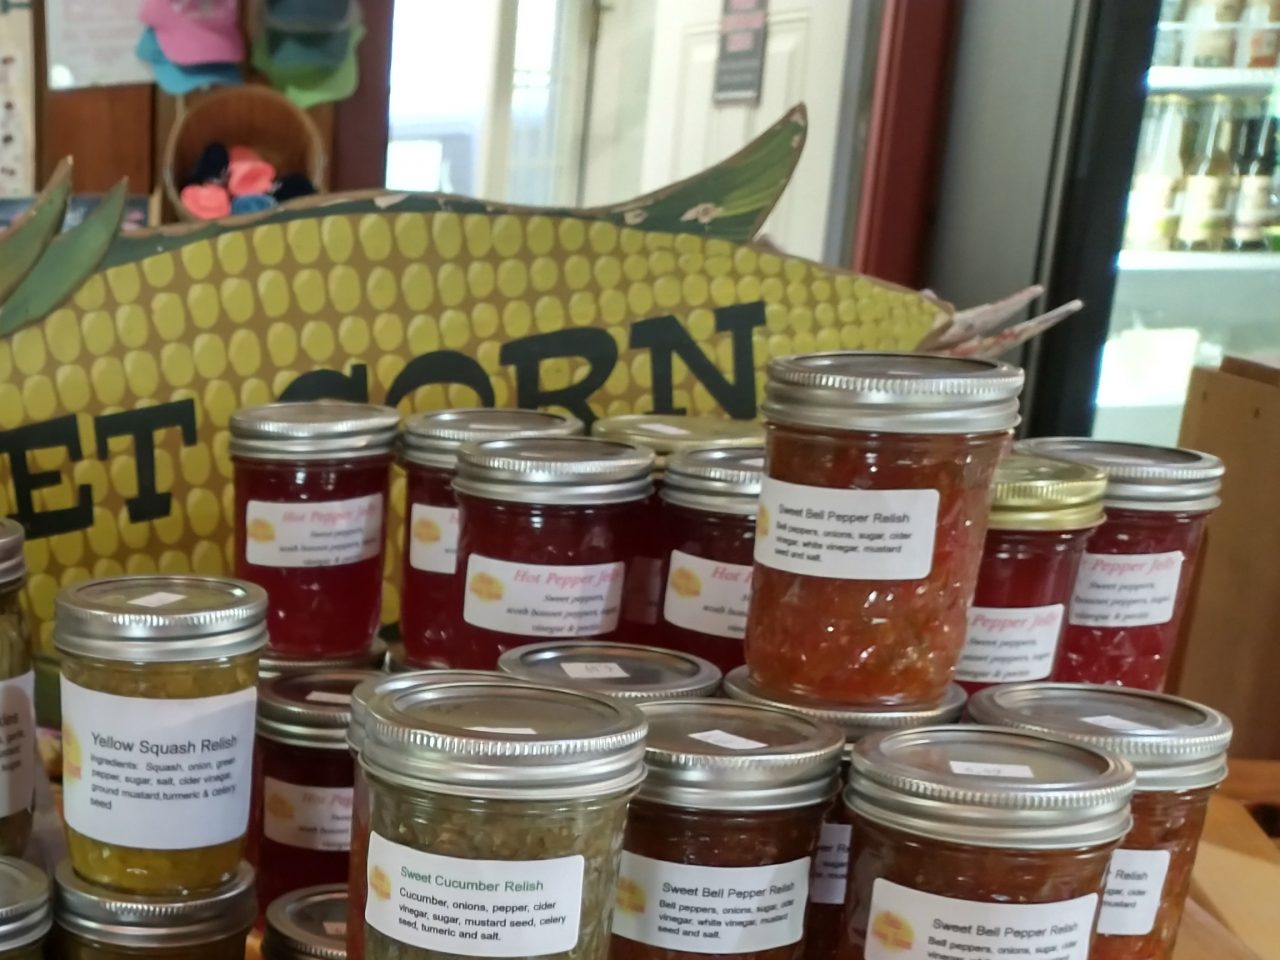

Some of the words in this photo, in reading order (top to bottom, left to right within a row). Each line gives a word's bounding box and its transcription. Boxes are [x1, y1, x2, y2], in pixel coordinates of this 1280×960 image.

[806, 509, 824, 519] Bell
[827, 511, 869, 523] Pepper
[873, 513, 910, 523] Relish
[91, 732, 134, 752] Yellow
[139, 740, 196, 757] Squash
[201, 734, 237, 750] Relish
[401, 866, 431, 884] Sweet
[435, 875, 499, 892] Cucumber
[504, 880, 543, 892] Relish
[1115, 869, 1148, 881] Relish
[399, 887, 449, 909] Cucumber,
[453, 900, 489, 913] onions,
[492, 904, 530, 914] pepper,
[533, 901, 556, 911] cider
[662, 882, 698, 896] Sweet
[702, 888, 724, 898] Bell
[728, 889, 767, 900] Pepper
[399, 904, 430, 920] vinegar,
[432, 914, 461, 926] sugar,
[465, 917, 506, 927] mustard
[510, 918, 536, 928] seed,
[539, 915, 566, 925] celery
[459, 930, 477, 939] and
[480, 931, 501, 941] salt.
[932, 918, 972, 935] Sweet
[976, 924, 1000, 937] Bell
[1004, 926, 1047, 939] Pepper
[1050, 921, 1078, 934] Relish
